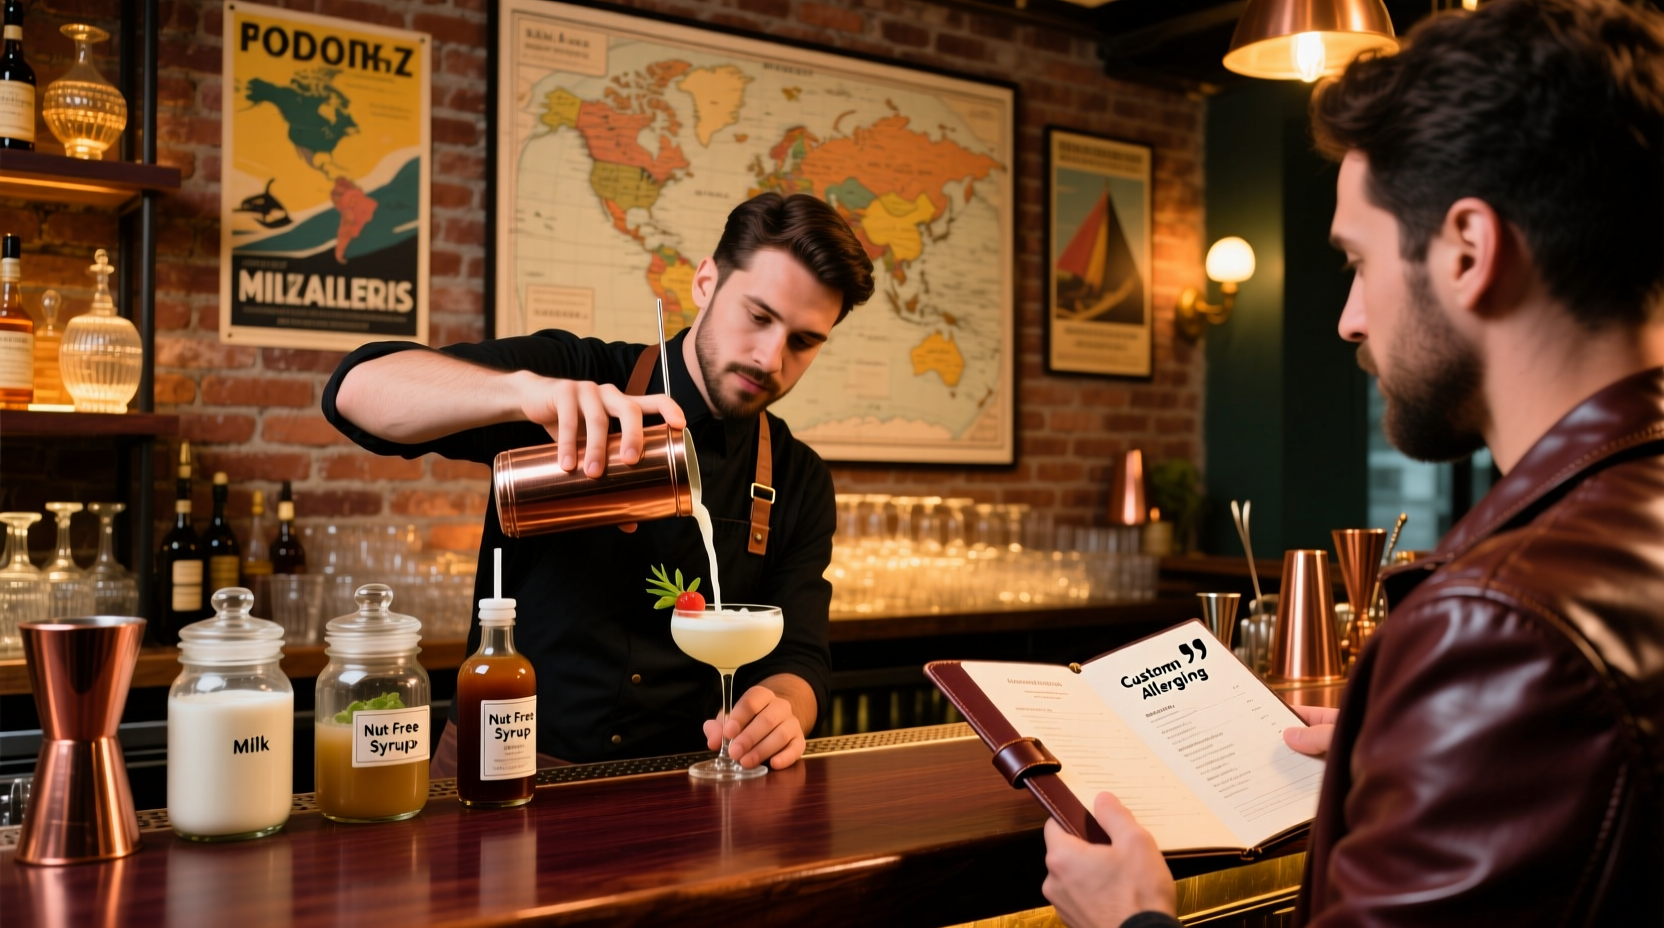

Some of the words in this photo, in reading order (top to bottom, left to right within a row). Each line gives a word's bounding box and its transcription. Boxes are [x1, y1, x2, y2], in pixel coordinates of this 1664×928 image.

[488, 713, 511, 726] Nut
[364, 723, 389, 738] Nut
[392, 722, 419, 735] Free
[494, 727, 531, 742] Syrup
[233, 735, 270, 755] Milk
